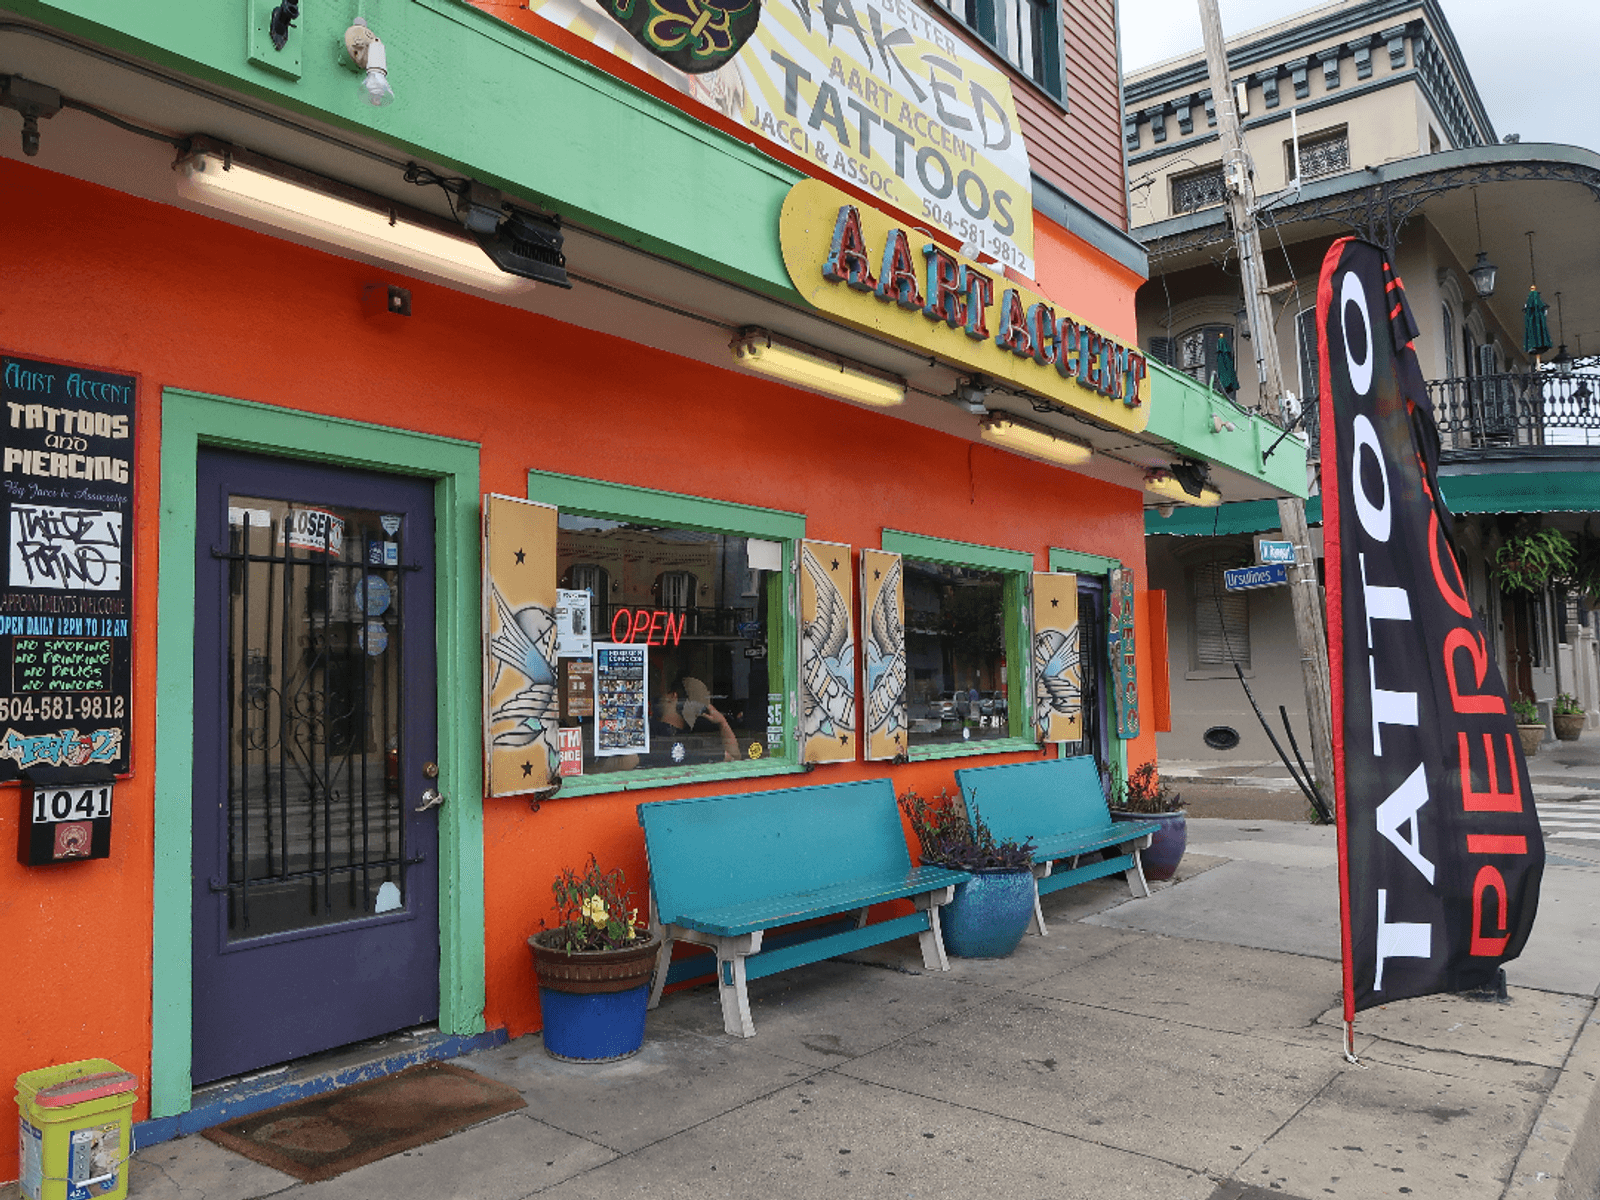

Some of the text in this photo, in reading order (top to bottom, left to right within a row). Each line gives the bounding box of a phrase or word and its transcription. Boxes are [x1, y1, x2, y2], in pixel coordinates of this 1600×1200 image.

[829, 56, 978, 167] AART ACCENT
[750, 106, 900, 202] JACCI & ASSOC.
[770, 49, 1015, 237] TATTOOS
[921, 197, 1027, 271] 504-581-9812
[822, 204, 1147, 408] AART ACCENT
[6, 401, 129, 439] TATTOOS
[3, 447, 129, 484] PIERCING
[1227, 570, 1271, 586] Ursulines
[0, 594, 126, 615] APPOINTMENTS WELCOME
[0, 615, 24, 635] OPEN
[26, 616, 55, 636] DAILY
[57, 617, 83, 636] 12PM
[85, 618, 98, 637] TO
[101, 618, 112, 637] 12
[611, 608, 685, 646] OPEN
[1340, 270, 1437, 992] TATTOO
[15, 651, 111, 665] NO DRINKING
[16, 640, 111, 652] NO SMOKING
[22, 679, 104, 691] NO MINORS
[24, 664, 103, 678] NO DRUGS
[0, 695, 125, 722] 504-581-9812
[558, 731, 580, 748] TM
[559, 750, 581, 762] SIDE
[35, 788, 109, 822] 1041
